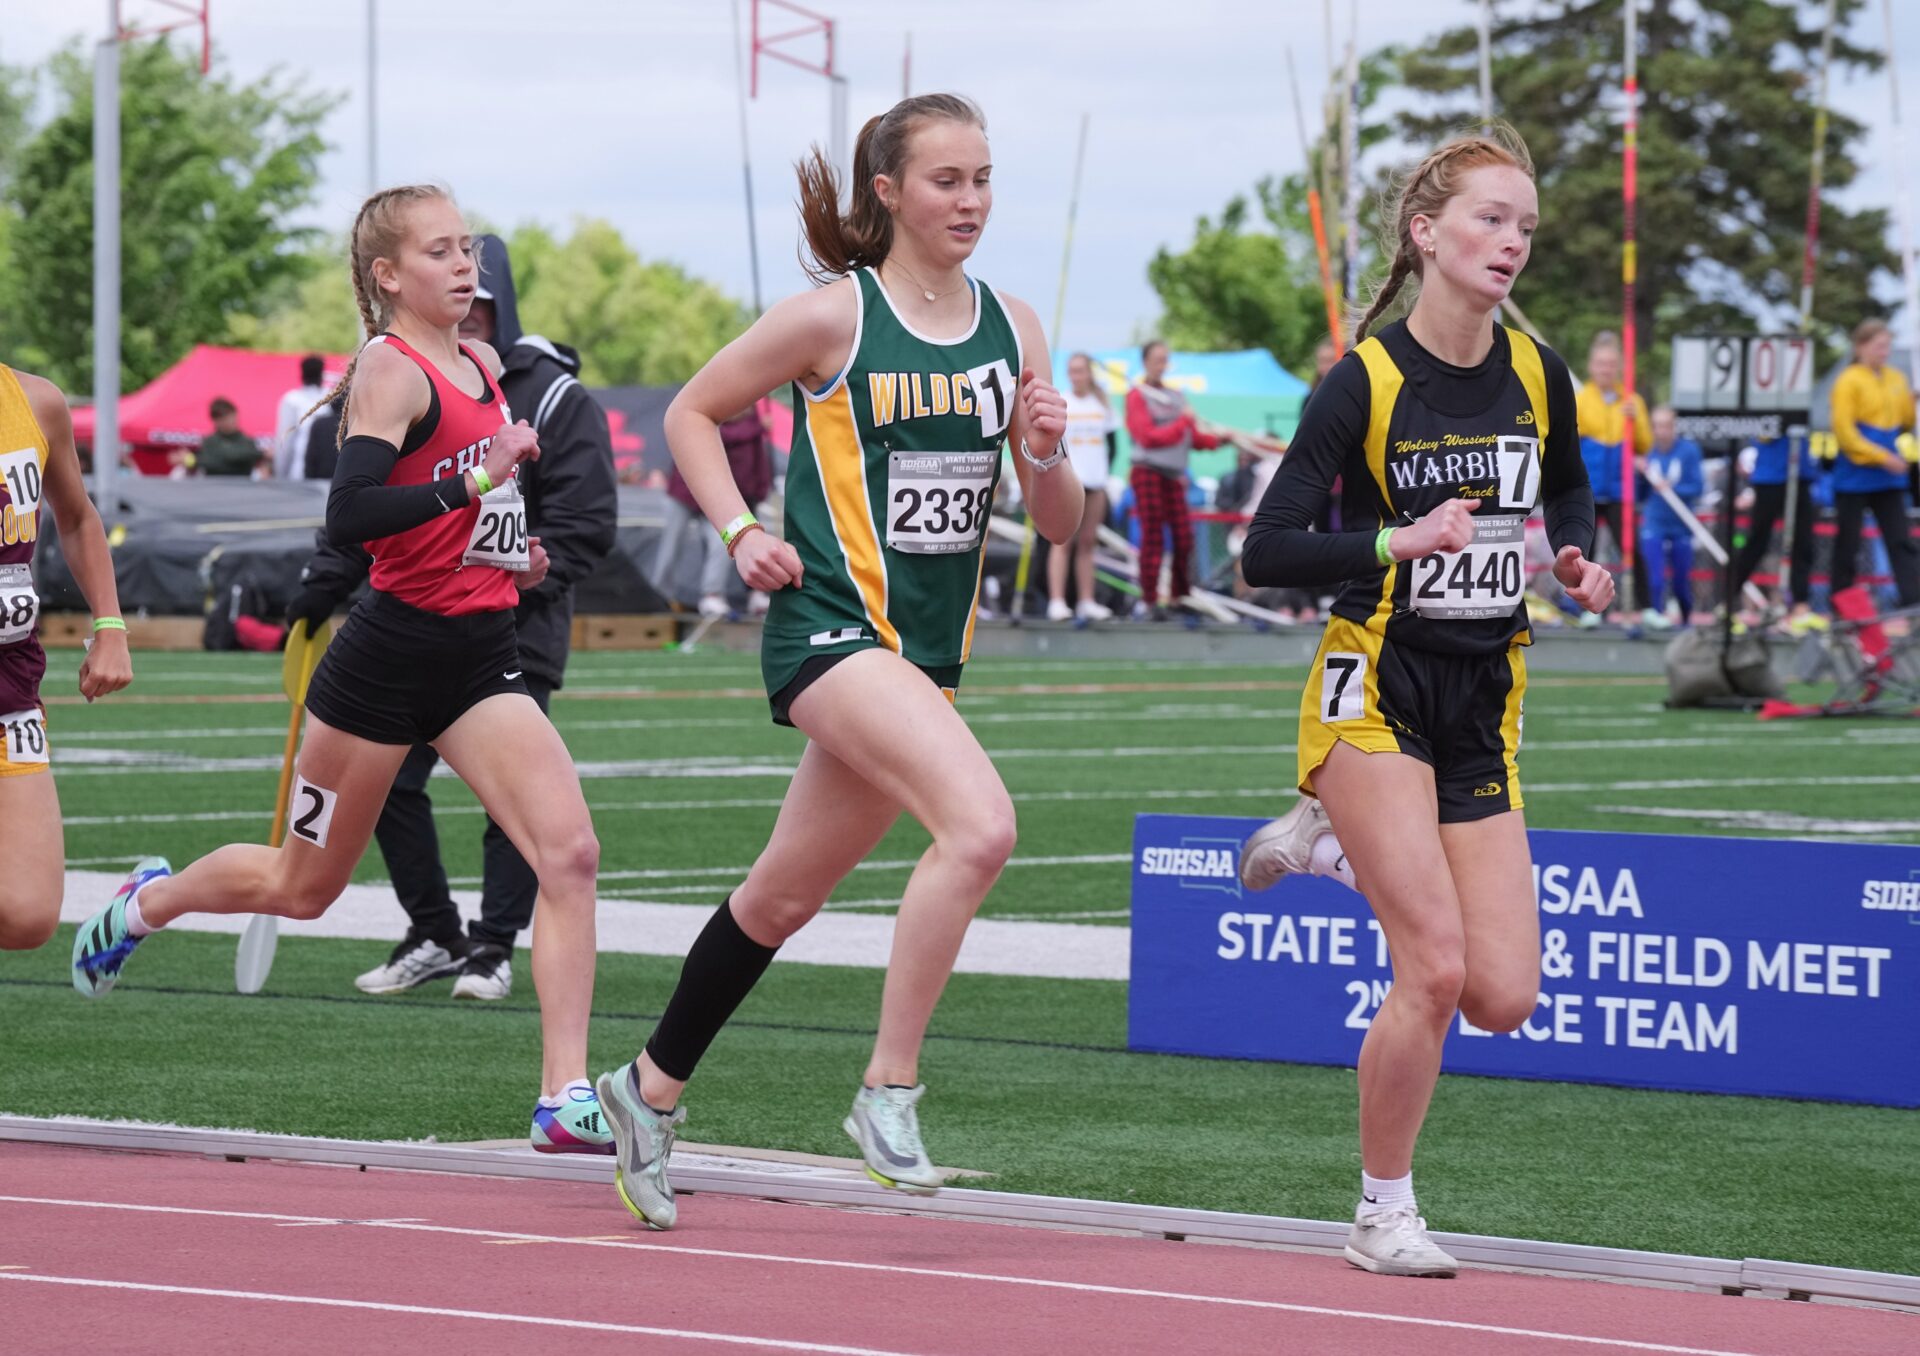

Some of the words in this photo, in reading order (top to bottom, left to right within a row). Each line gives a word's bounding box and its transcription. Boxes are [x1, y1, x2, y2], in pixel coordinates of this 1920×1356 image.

[868, 373, 986, 428] WILDC
[980, 367, 1005, 428] 1
[6, 461, 40, 505] 10
[432, 435, 498, 482] CHE
[1504, 442, 1532, 502] 7
[1459, 485, 1494, 499] Track
[1417, 550, 1521, 599] 2440
[1326, 657, 1359, 718] 7
[8, 718, 44, 754] 10
[294, 785, 325, 842] 2
[1140, 846, 1236, 878] SDHSAA
[1861, 880, 1920, 912] SDH
[1216, 911, 1357, 967] STATE
[1541, 928, 1574, 979] &
[1588, 931, 1732, 988] FIELD
[1747, 940, 1892, 998] MEET
[1595, 996, 1738, 1055] TEAM
